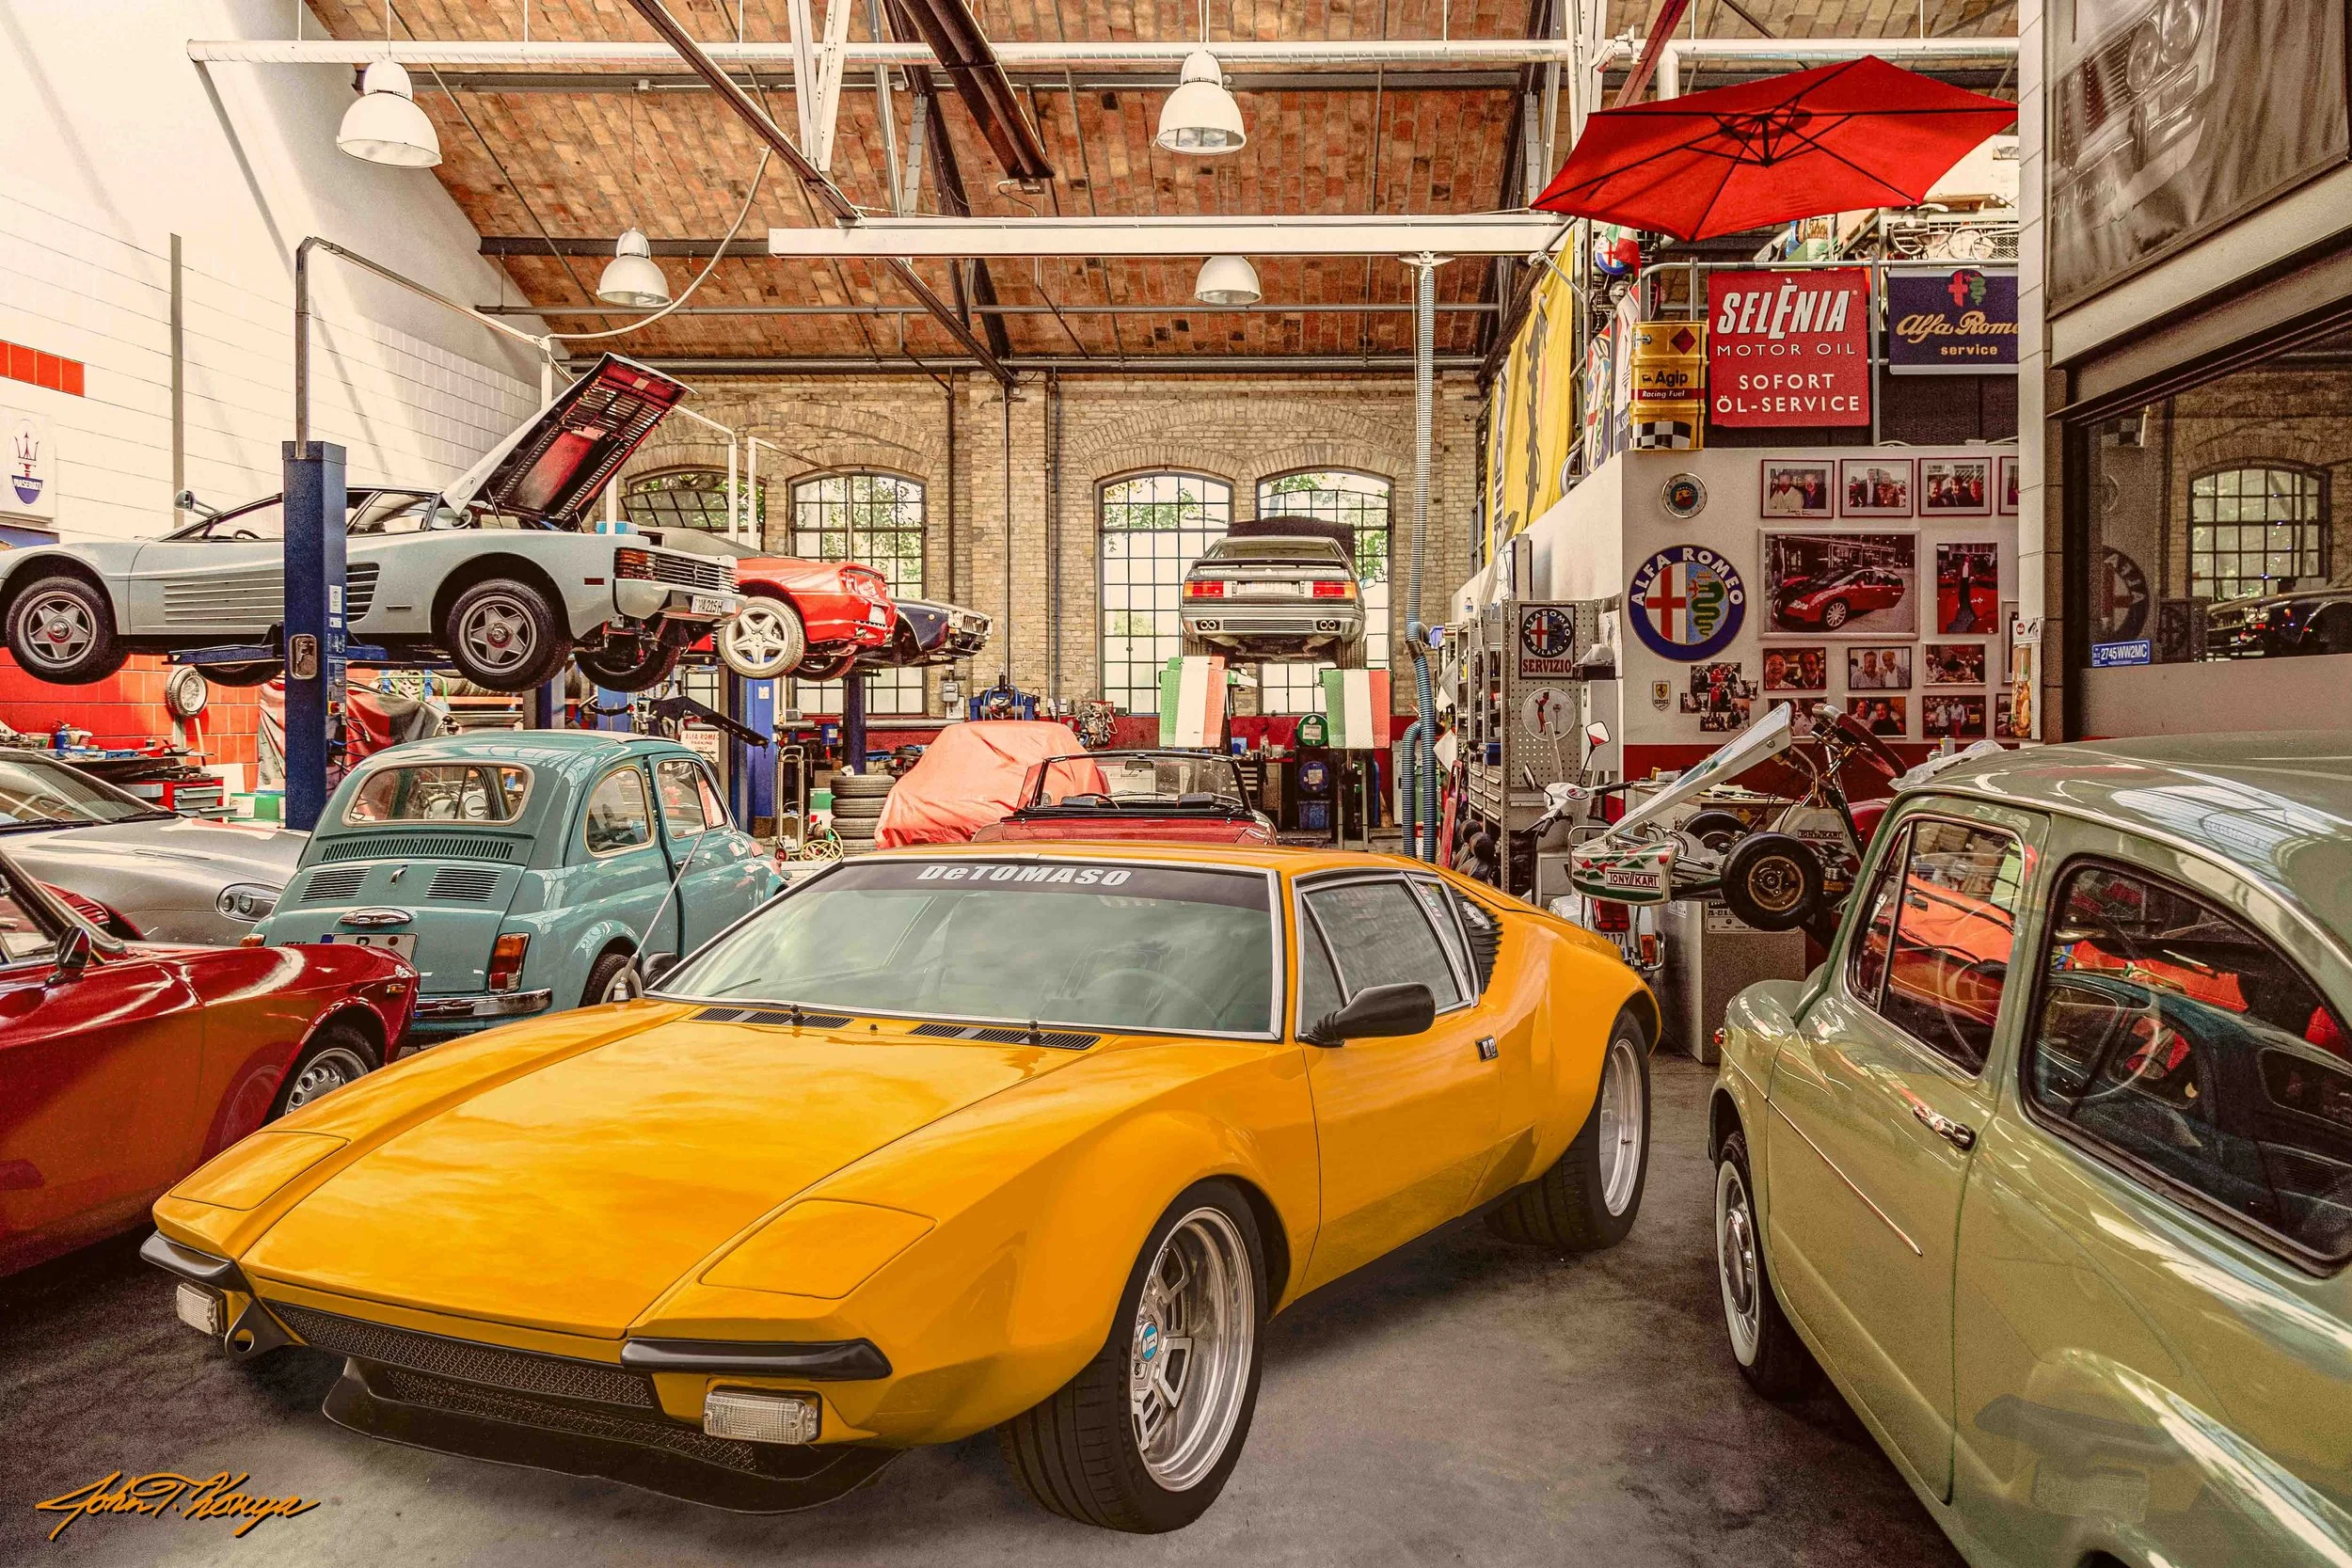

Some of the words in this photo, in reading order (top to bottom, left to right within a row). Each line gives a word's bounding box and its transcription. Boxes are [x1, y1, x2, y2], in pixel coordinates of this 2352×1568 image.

[1716, 277, 1850, 340] SELÈNIA
[1896, 313, 1954, 344] Alfa
[1954, 310, 2018, 336] Rom
[1717, 343, 1802, 356] MOTOR
[1816, 342, 1856, 356] OIL
[1940, 343, 1998, 356] service
[1655, 369, 1688, 388] Agip
[1739, 373, 1835, 390] SOFORT
[1642, 389, 1667, 399] Racing
[1668, 389, 1686, 398] Fuel
[1716, 394, 1860, 413] ÖL-SERVICE
[1630, 553, 1672, 607] ALFA
[1682, 547, 1743, 605] ROMEO
[1532, 645, 1564, 656] MILANO
[1522, 658, 1572, 673] SERVIZIO
[916, 865, 1132, 886] DeTOMASO
[1607, 871, 1630, 884] TONY
[1634, 873, 1660, 887] KART
